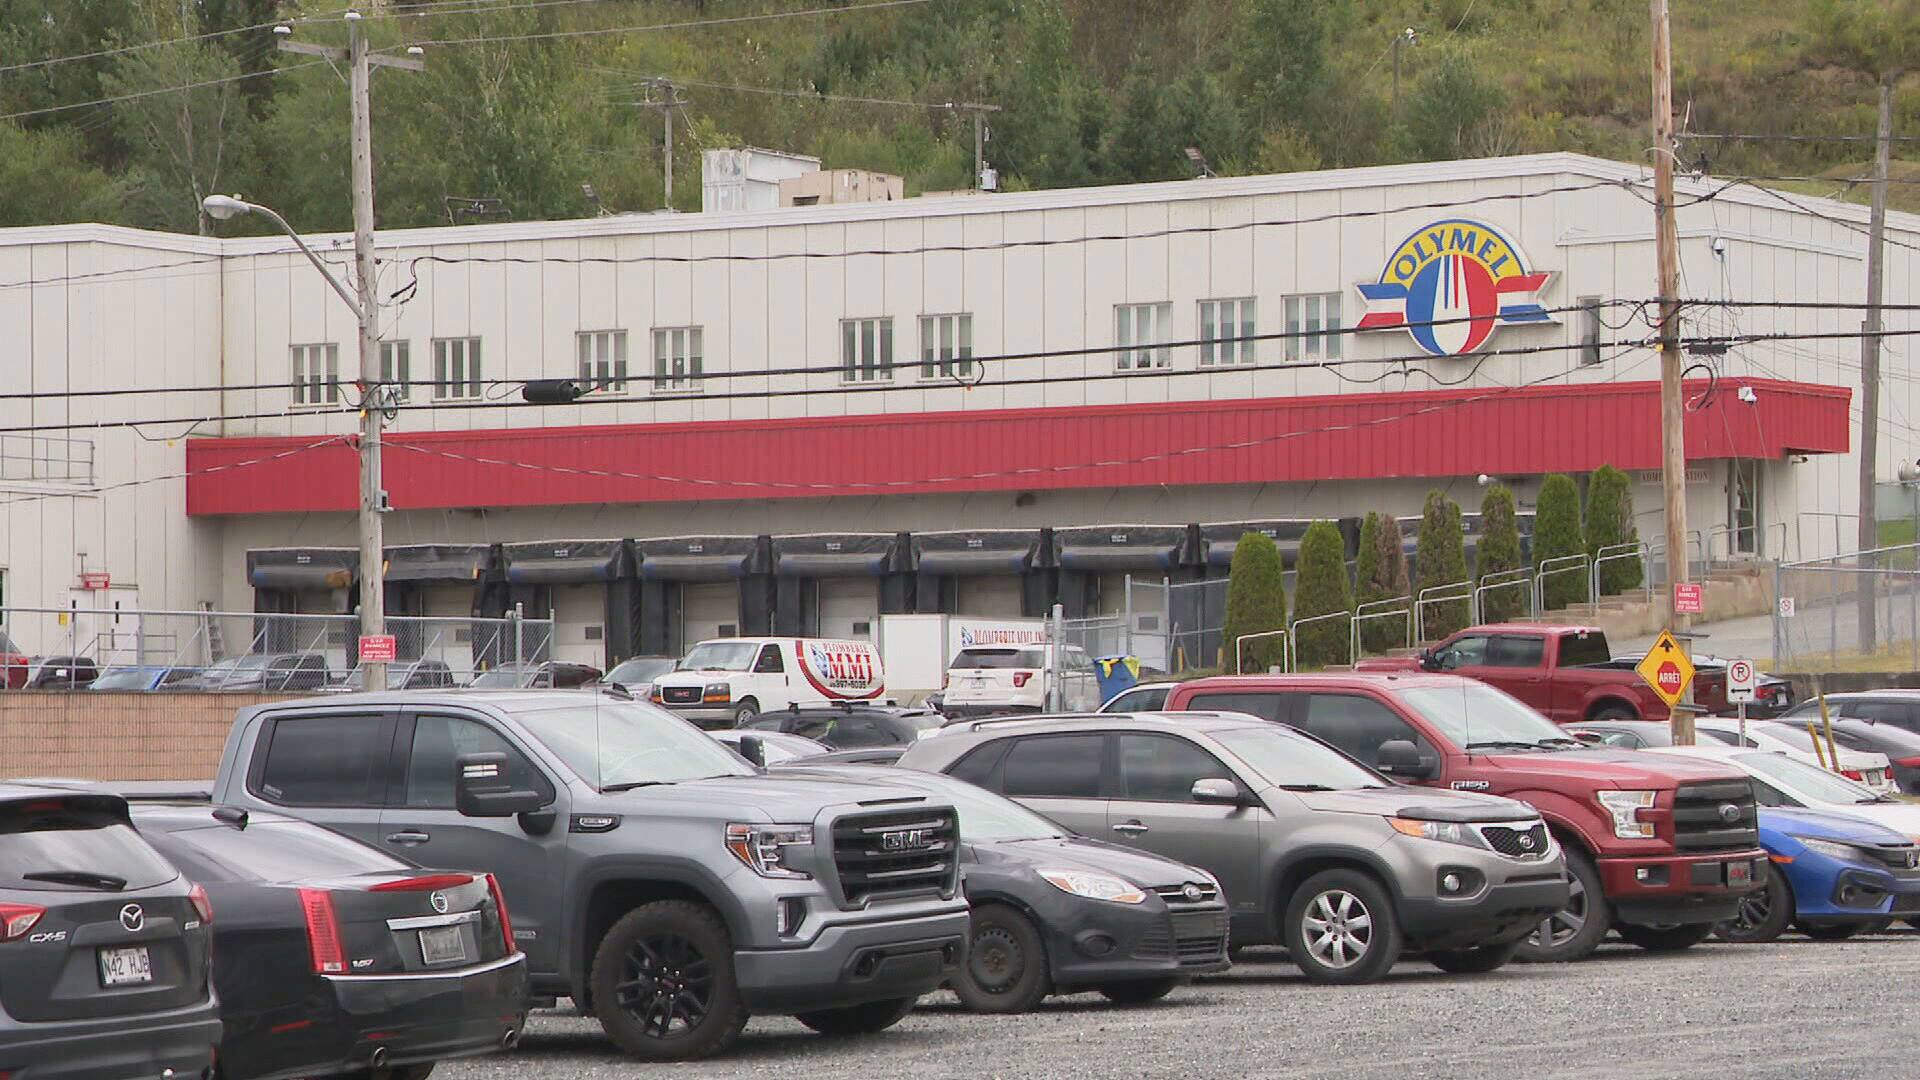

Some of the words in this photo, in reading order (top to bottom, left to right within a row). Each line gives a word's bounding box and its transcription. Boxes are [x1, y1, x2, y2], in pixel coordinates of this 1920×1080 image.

[1394, 228, 1509, 280] OLYMEL
[823, 642, 869, 653] PLOMBERIE
[826, 652, 873, 685] MMJ
[1659, 671, 1680, 684] ARRÊT
[882, 829, 934, 850] GMC
[30, 931, 66, 942] CX-5
